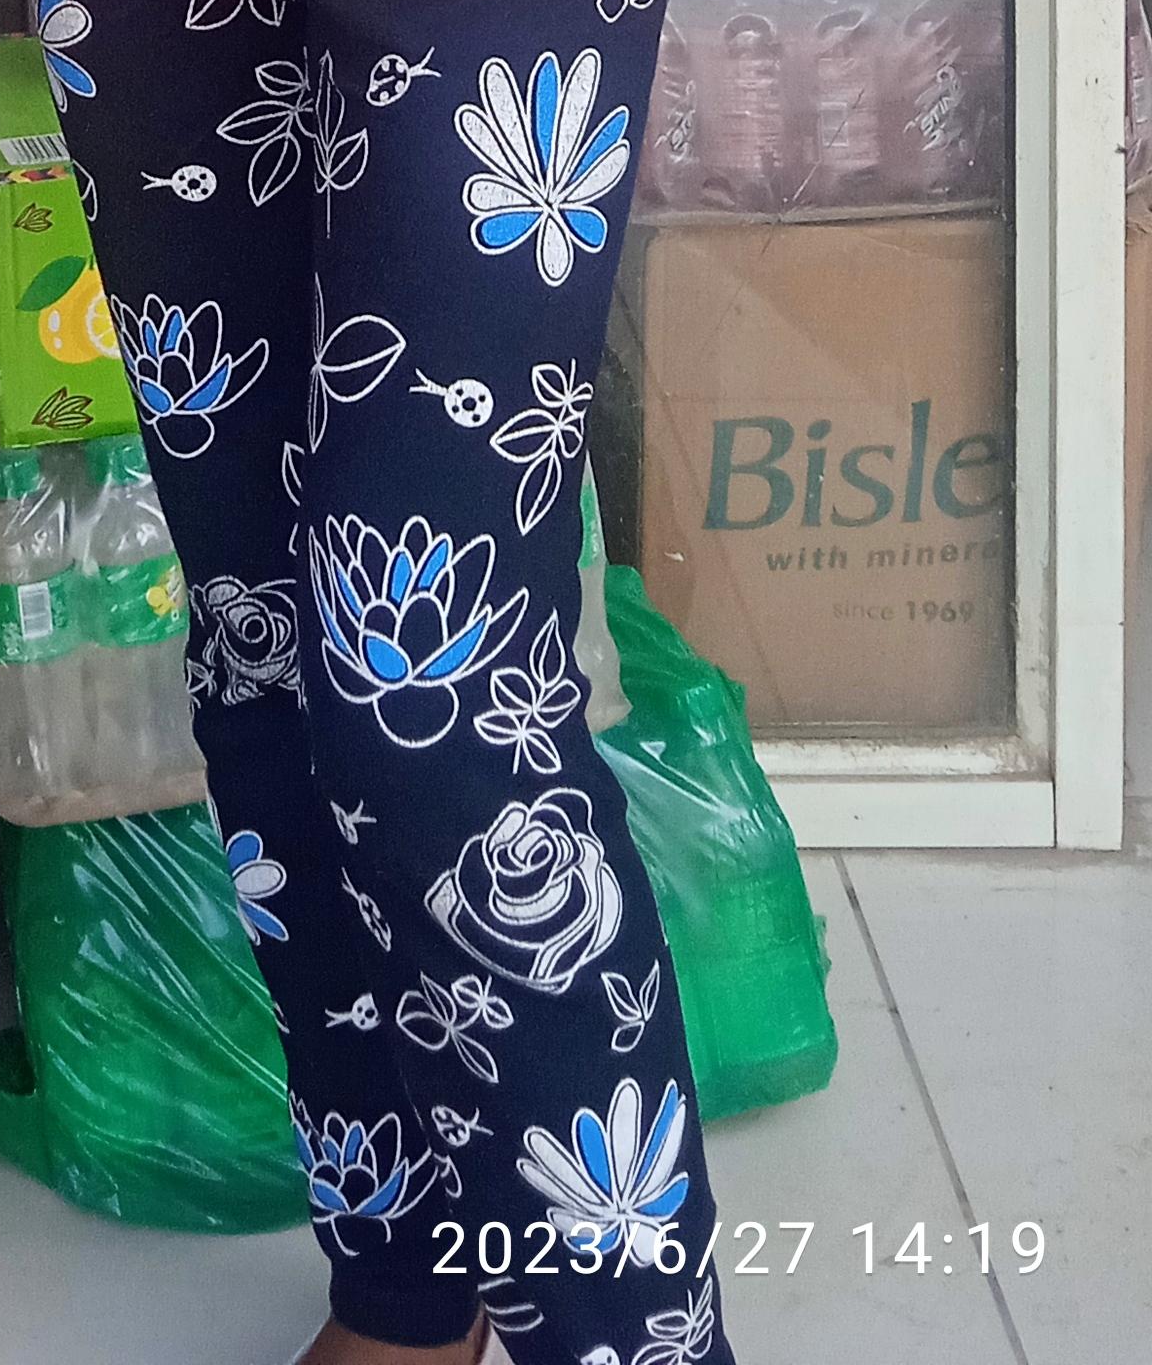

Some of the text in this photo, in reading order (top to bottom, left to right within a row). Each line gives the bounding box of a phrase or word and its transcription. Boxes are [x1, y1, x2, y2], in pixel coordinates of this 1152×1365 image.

[700, 398, 1005, 531] Bisle
[765, 538, 1000, 572] with minera
[832, 600, 975, 624] since 1969
